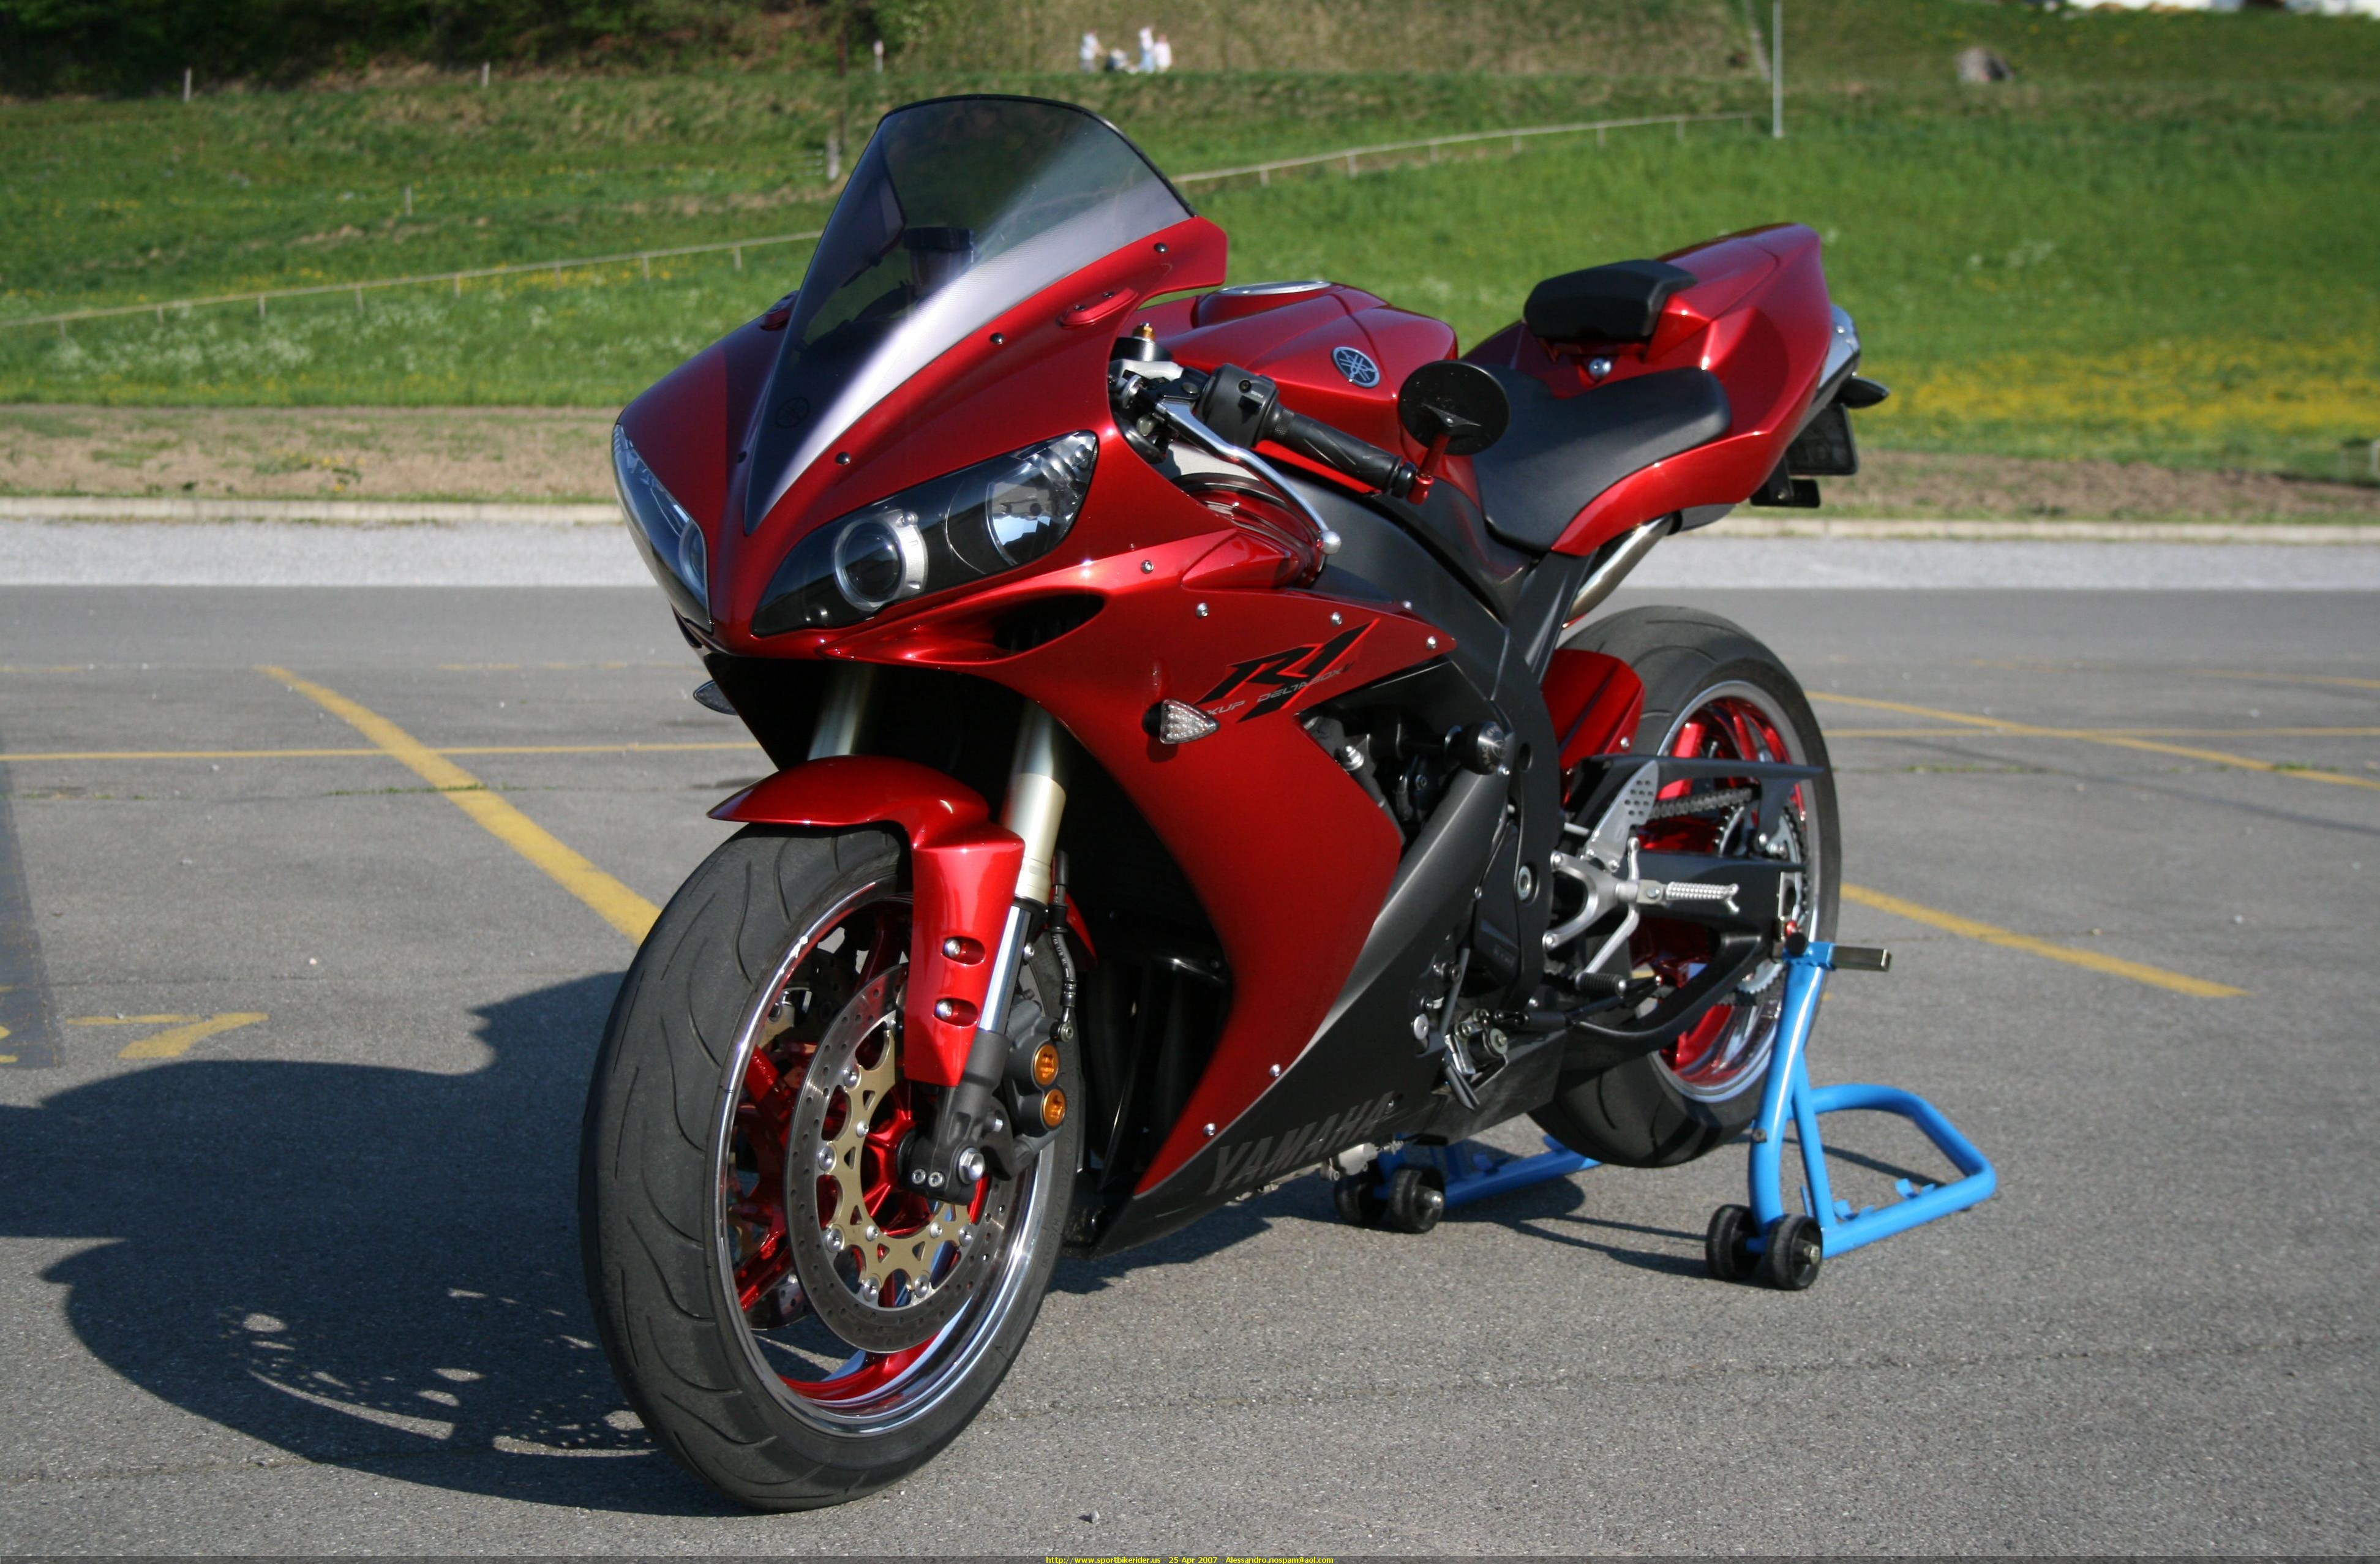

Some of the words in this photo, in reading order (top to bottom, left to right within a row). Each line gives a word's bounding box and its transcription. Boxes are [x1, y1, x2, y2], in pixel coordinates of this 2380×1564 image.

[1194, 618, 1380, 723] R1
[1257, 666, 1345, 702] DELTABOX
[1206, 1090, 1394, 1195] YAMAHA
